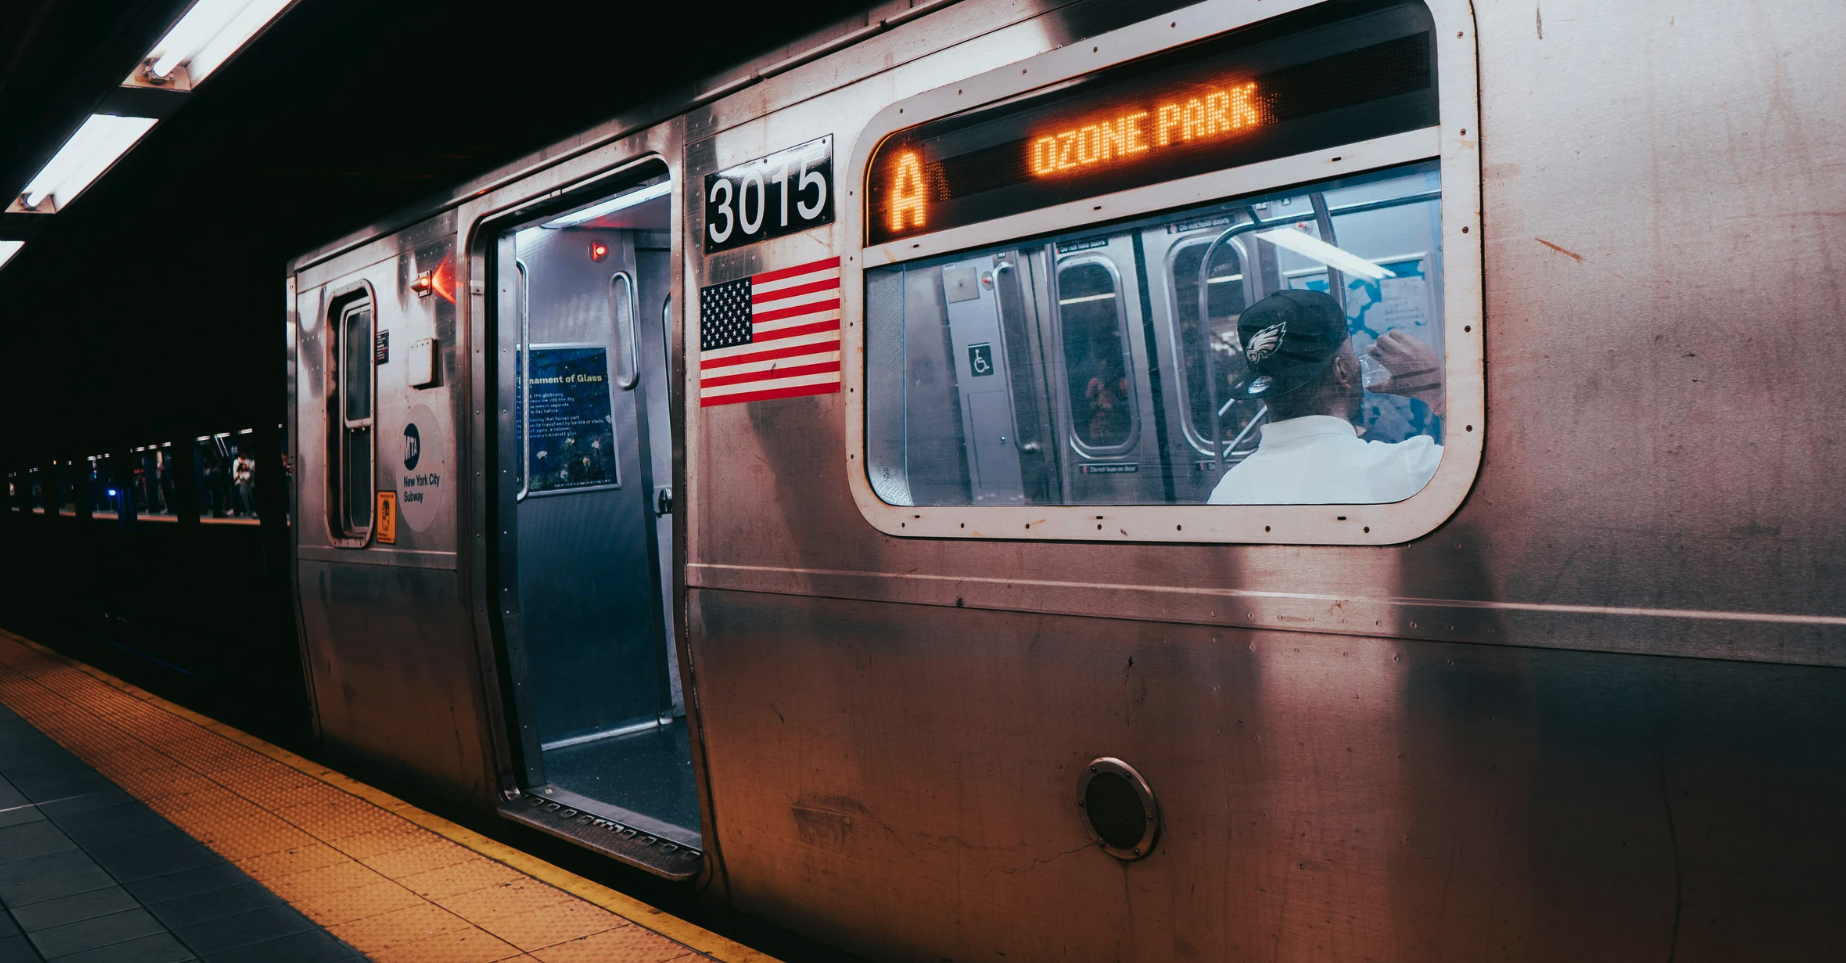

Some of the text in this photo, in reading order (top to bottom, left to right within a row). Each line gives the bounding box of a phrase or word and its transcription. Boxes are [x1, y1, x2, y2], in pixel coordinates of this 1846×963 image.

[1034, 82, 1256, 175] OZONE PARK
[708, 152, 828, 244] 3015
[891, 152, 926, 232] A
[566, 374, 575, 382] of
[577, 374, 602, 382] Glass
[404, 472, 440, 488] New York City
[404, 491, 424, 504] Subway
